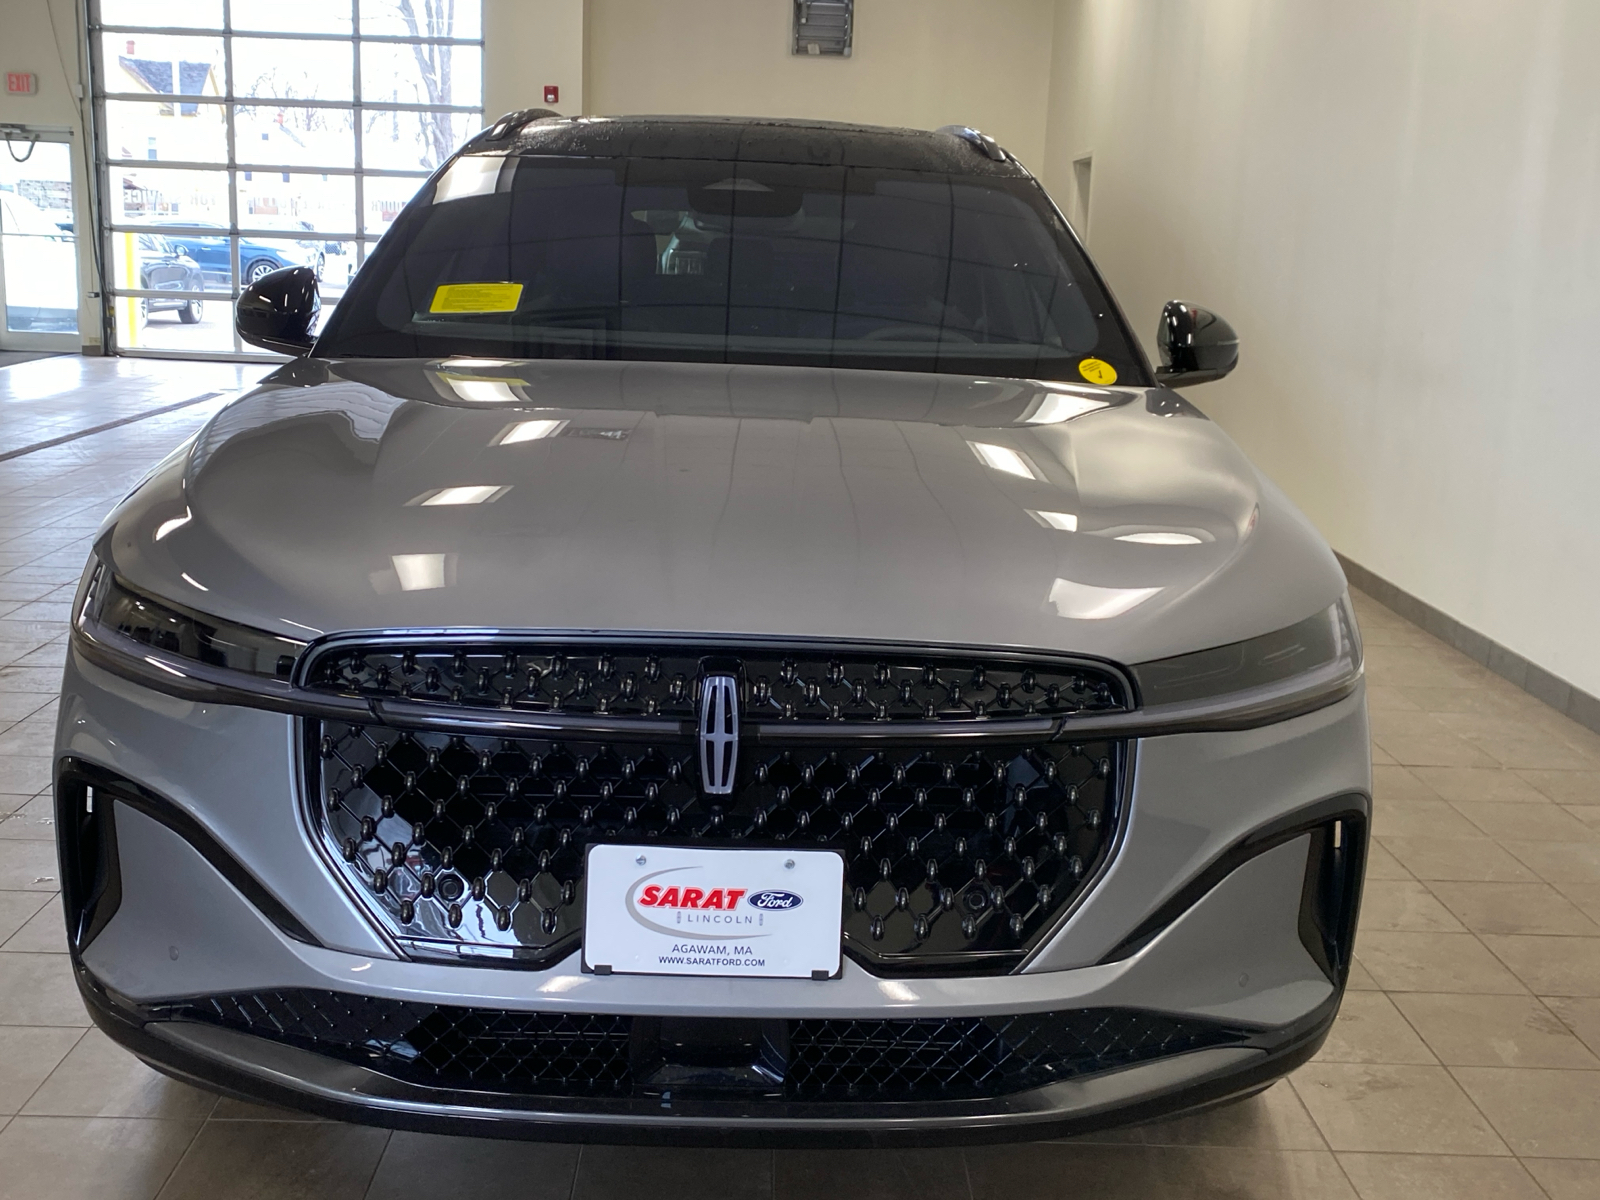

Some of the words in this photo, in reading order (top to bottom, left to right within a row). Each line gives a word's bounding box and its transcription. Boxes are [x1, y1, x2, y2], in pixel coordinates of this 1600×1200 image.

[7, 73, 30, 92] EXIT
[637, 884, 748, 911] SARAT
[757, 892, 793, 909] Ford
[687, 914, 753, 924] LINCOLN
[671, 944, 730, 956] AGAWAM,
[734, 945, 753, 955] MA
[658, 956, 766, 967] WWW.SARATFORD.COM
